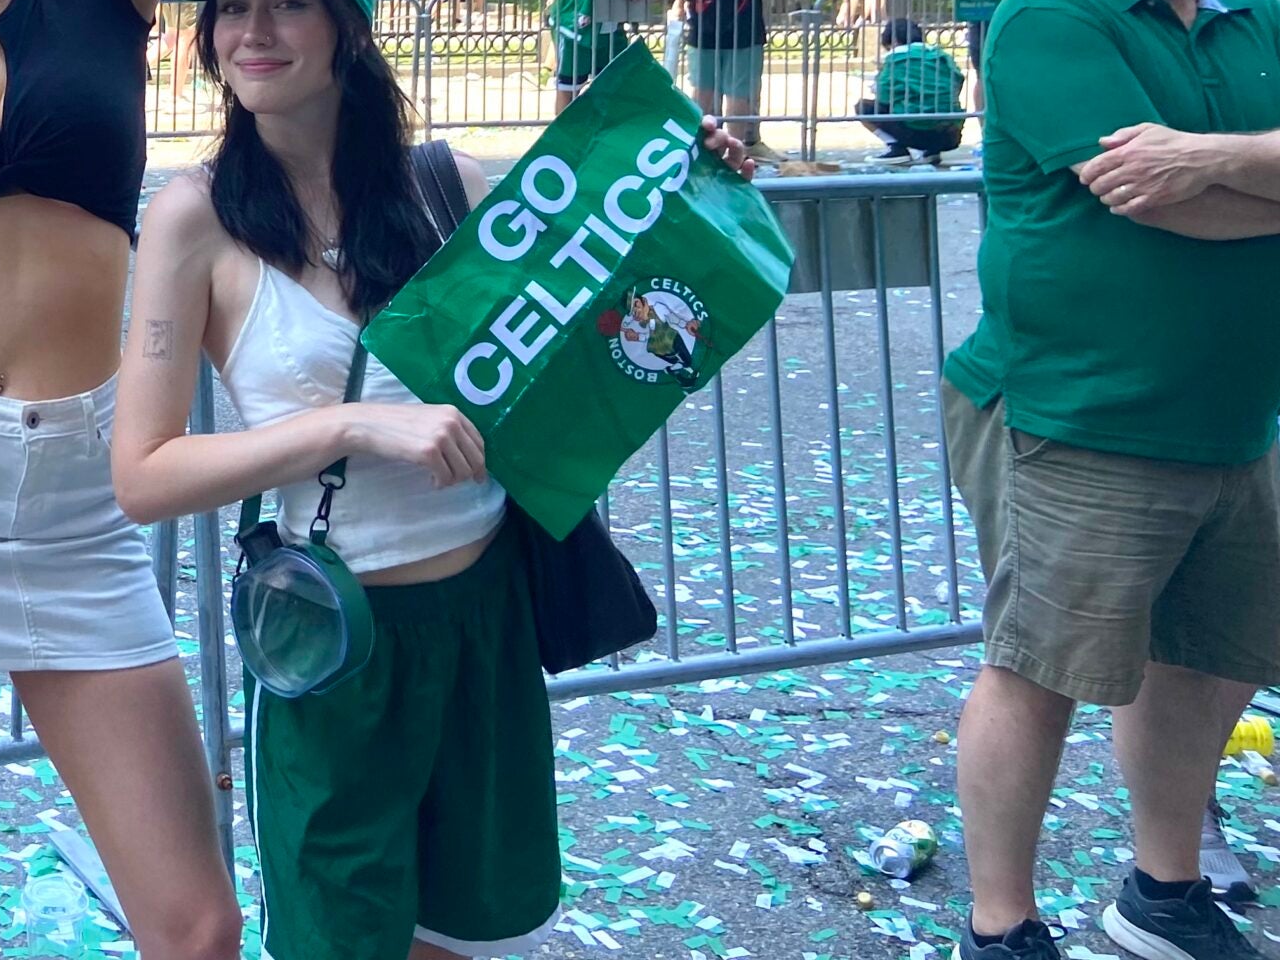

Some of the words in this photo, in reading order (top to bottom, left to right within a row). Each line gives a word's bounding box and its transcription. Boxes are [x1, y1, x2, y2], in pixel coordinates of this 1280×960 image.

[478, 154, 578, 262] GO
[453, 118, 699, 406] CELTICS!
[650, 278, 709, 322] CELTICS
[608, 337, 658, 382] BOSTON
